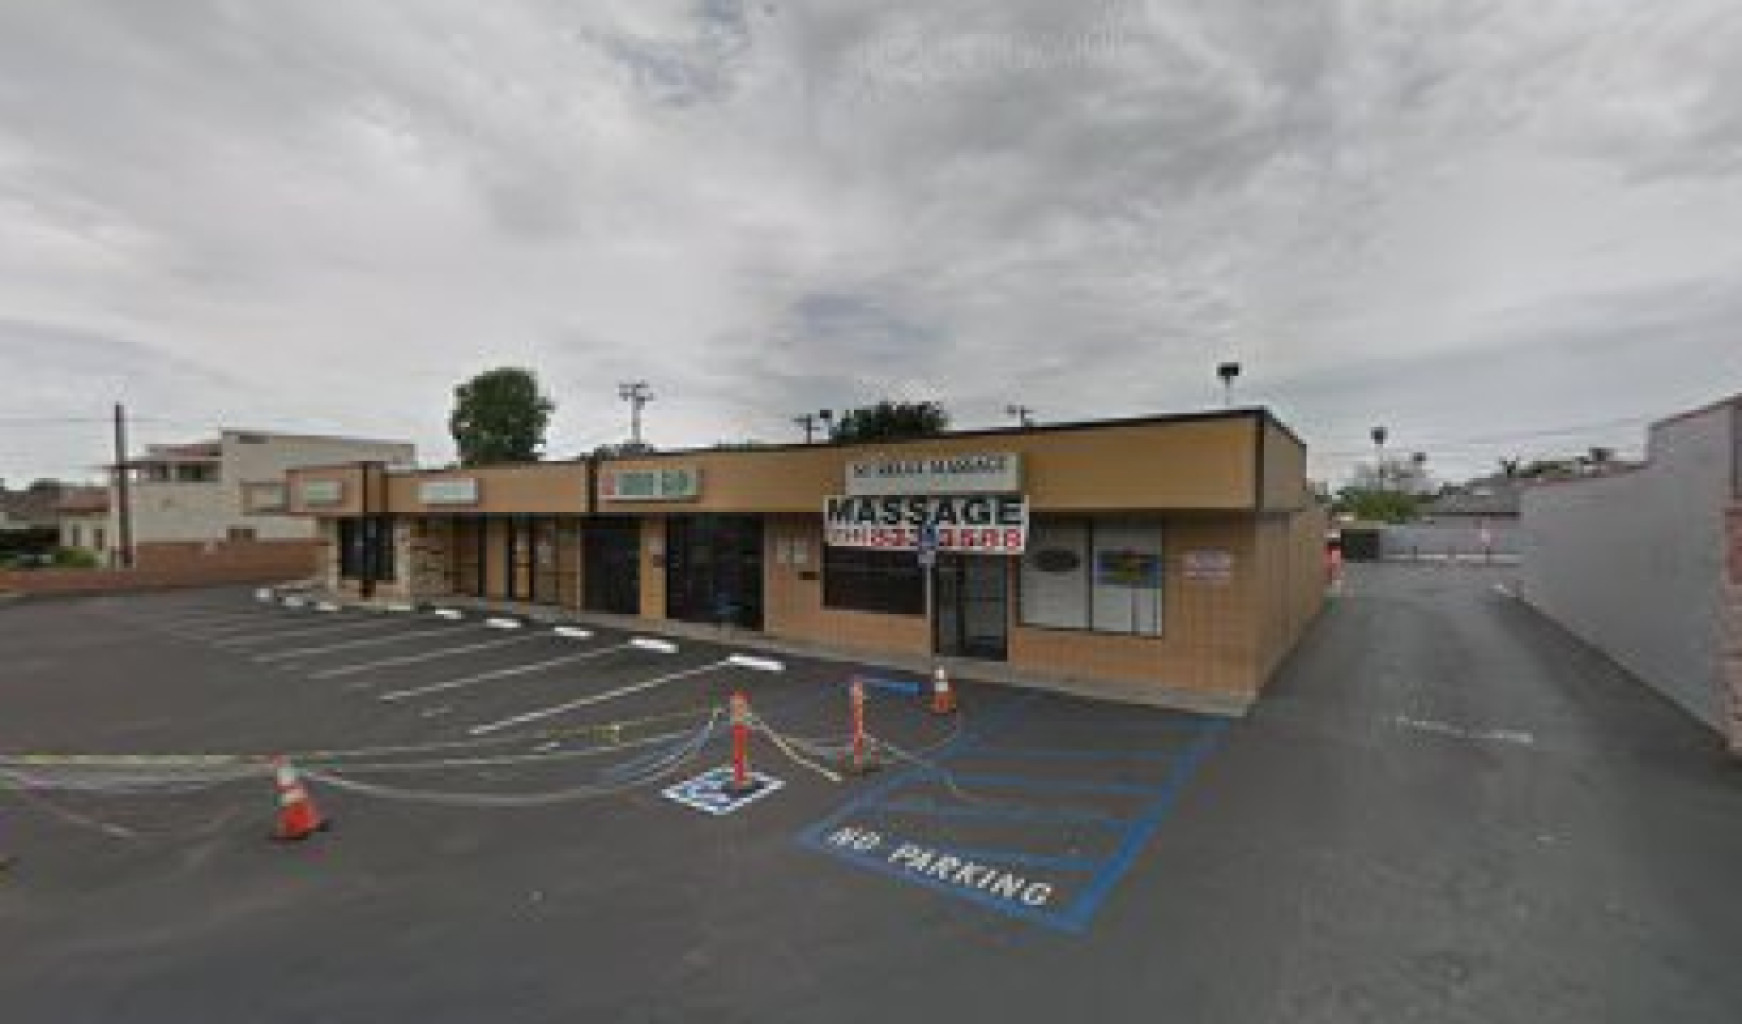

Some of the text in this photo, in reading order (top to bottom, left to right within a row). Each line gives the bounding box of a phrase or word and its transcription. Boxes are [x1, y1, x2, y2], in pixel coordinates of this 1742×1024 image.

[828, 495, 1024, 524] MASSAGE
[828, 826, 1053, 906] NO PARKING
